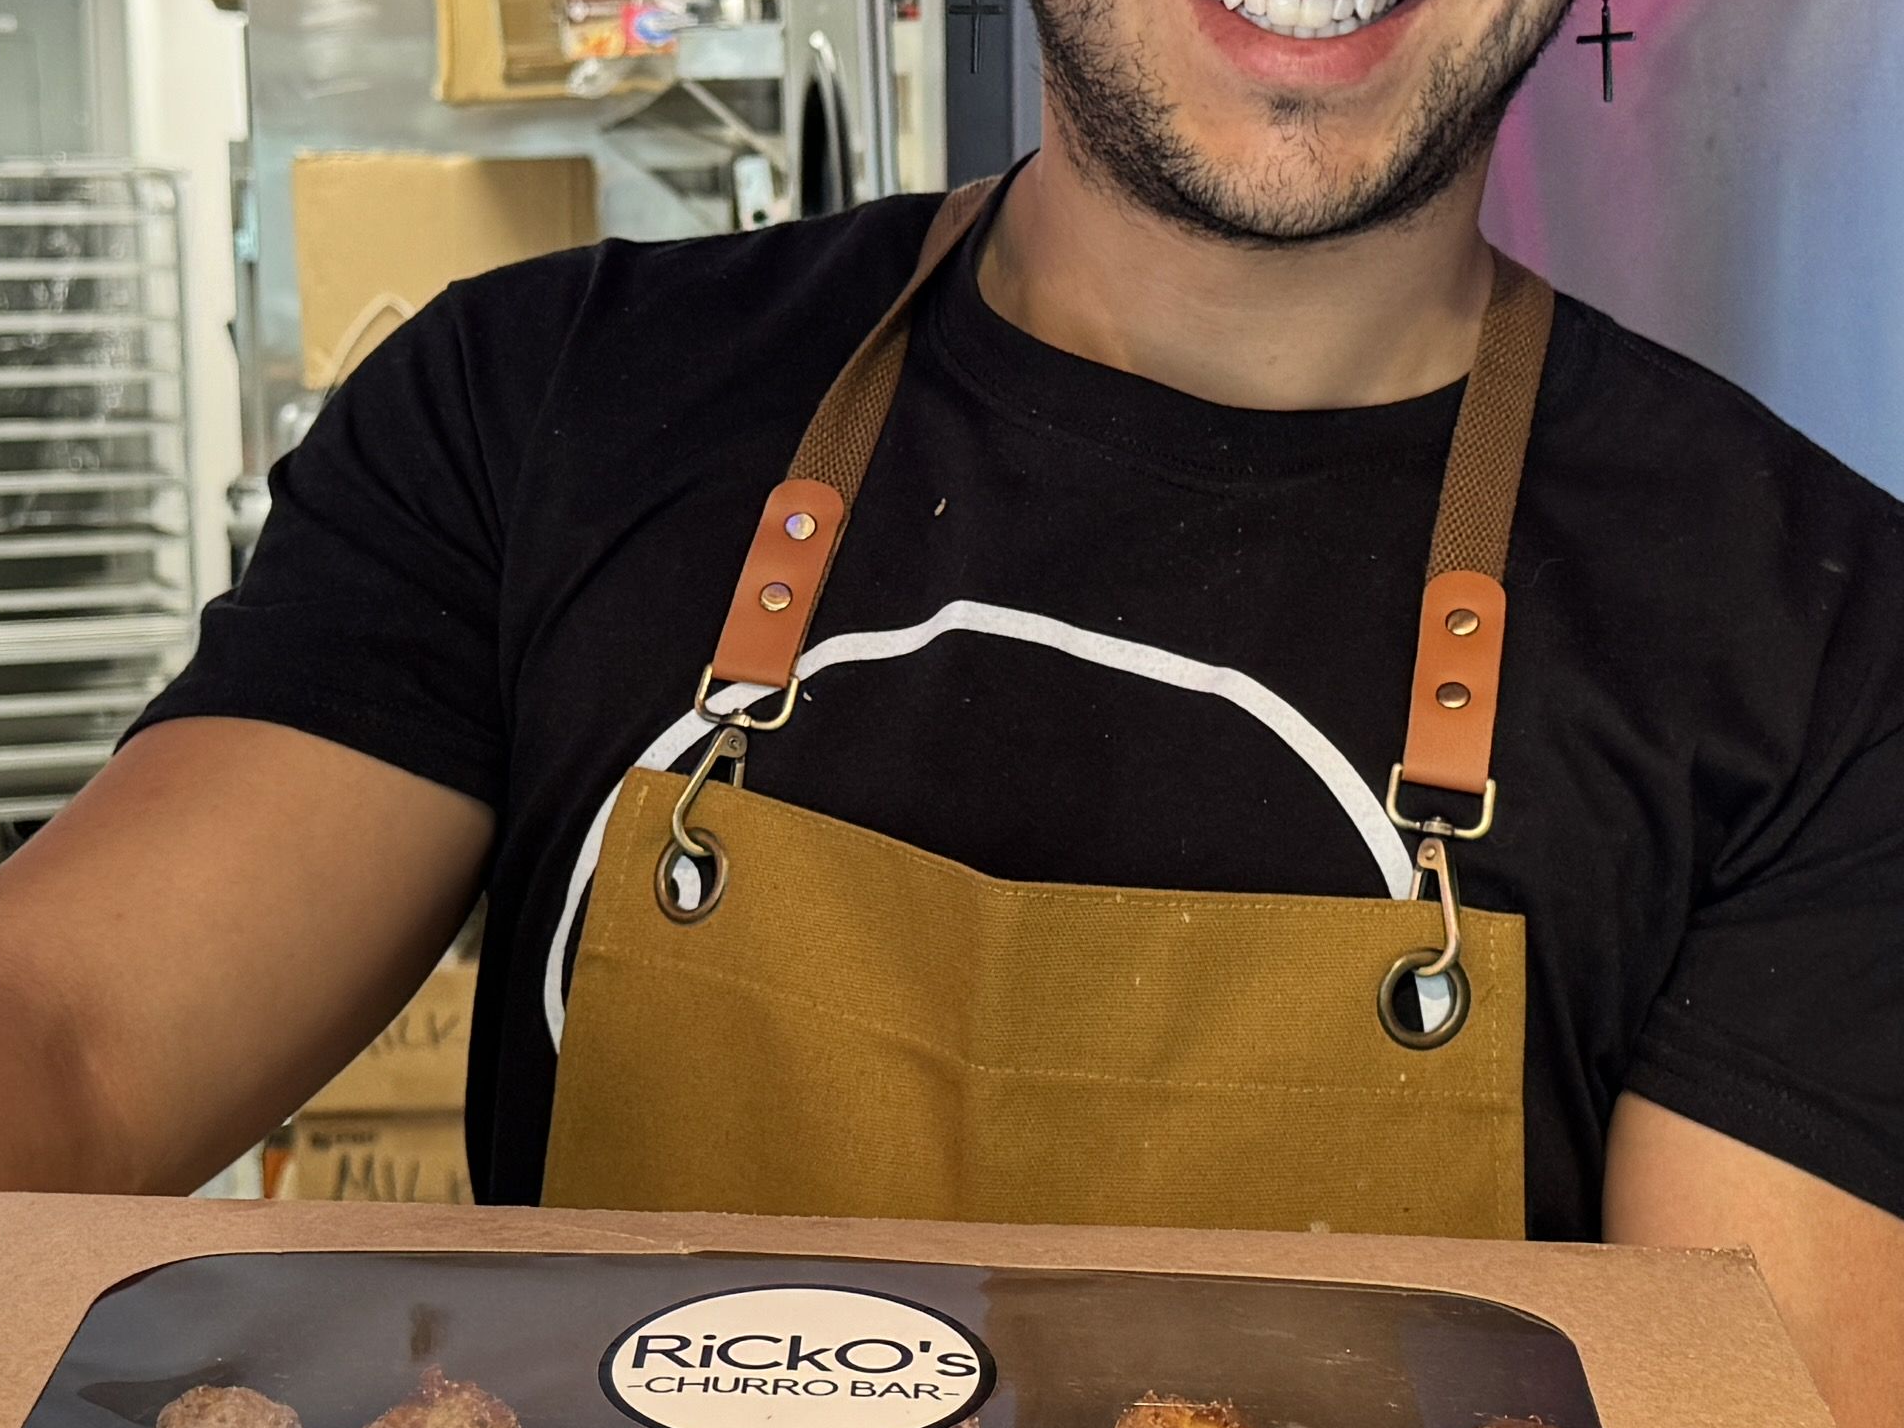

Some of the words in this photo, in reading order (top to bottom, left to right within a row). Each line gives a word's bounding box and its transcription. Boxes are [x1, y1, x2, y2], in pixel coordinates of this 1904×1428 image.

[631, 1334, 977, 1377] RiCkO's
[626, 1376, 838, 1396] -CHURRO
[850, 1379, 961, 1400] BAR-
